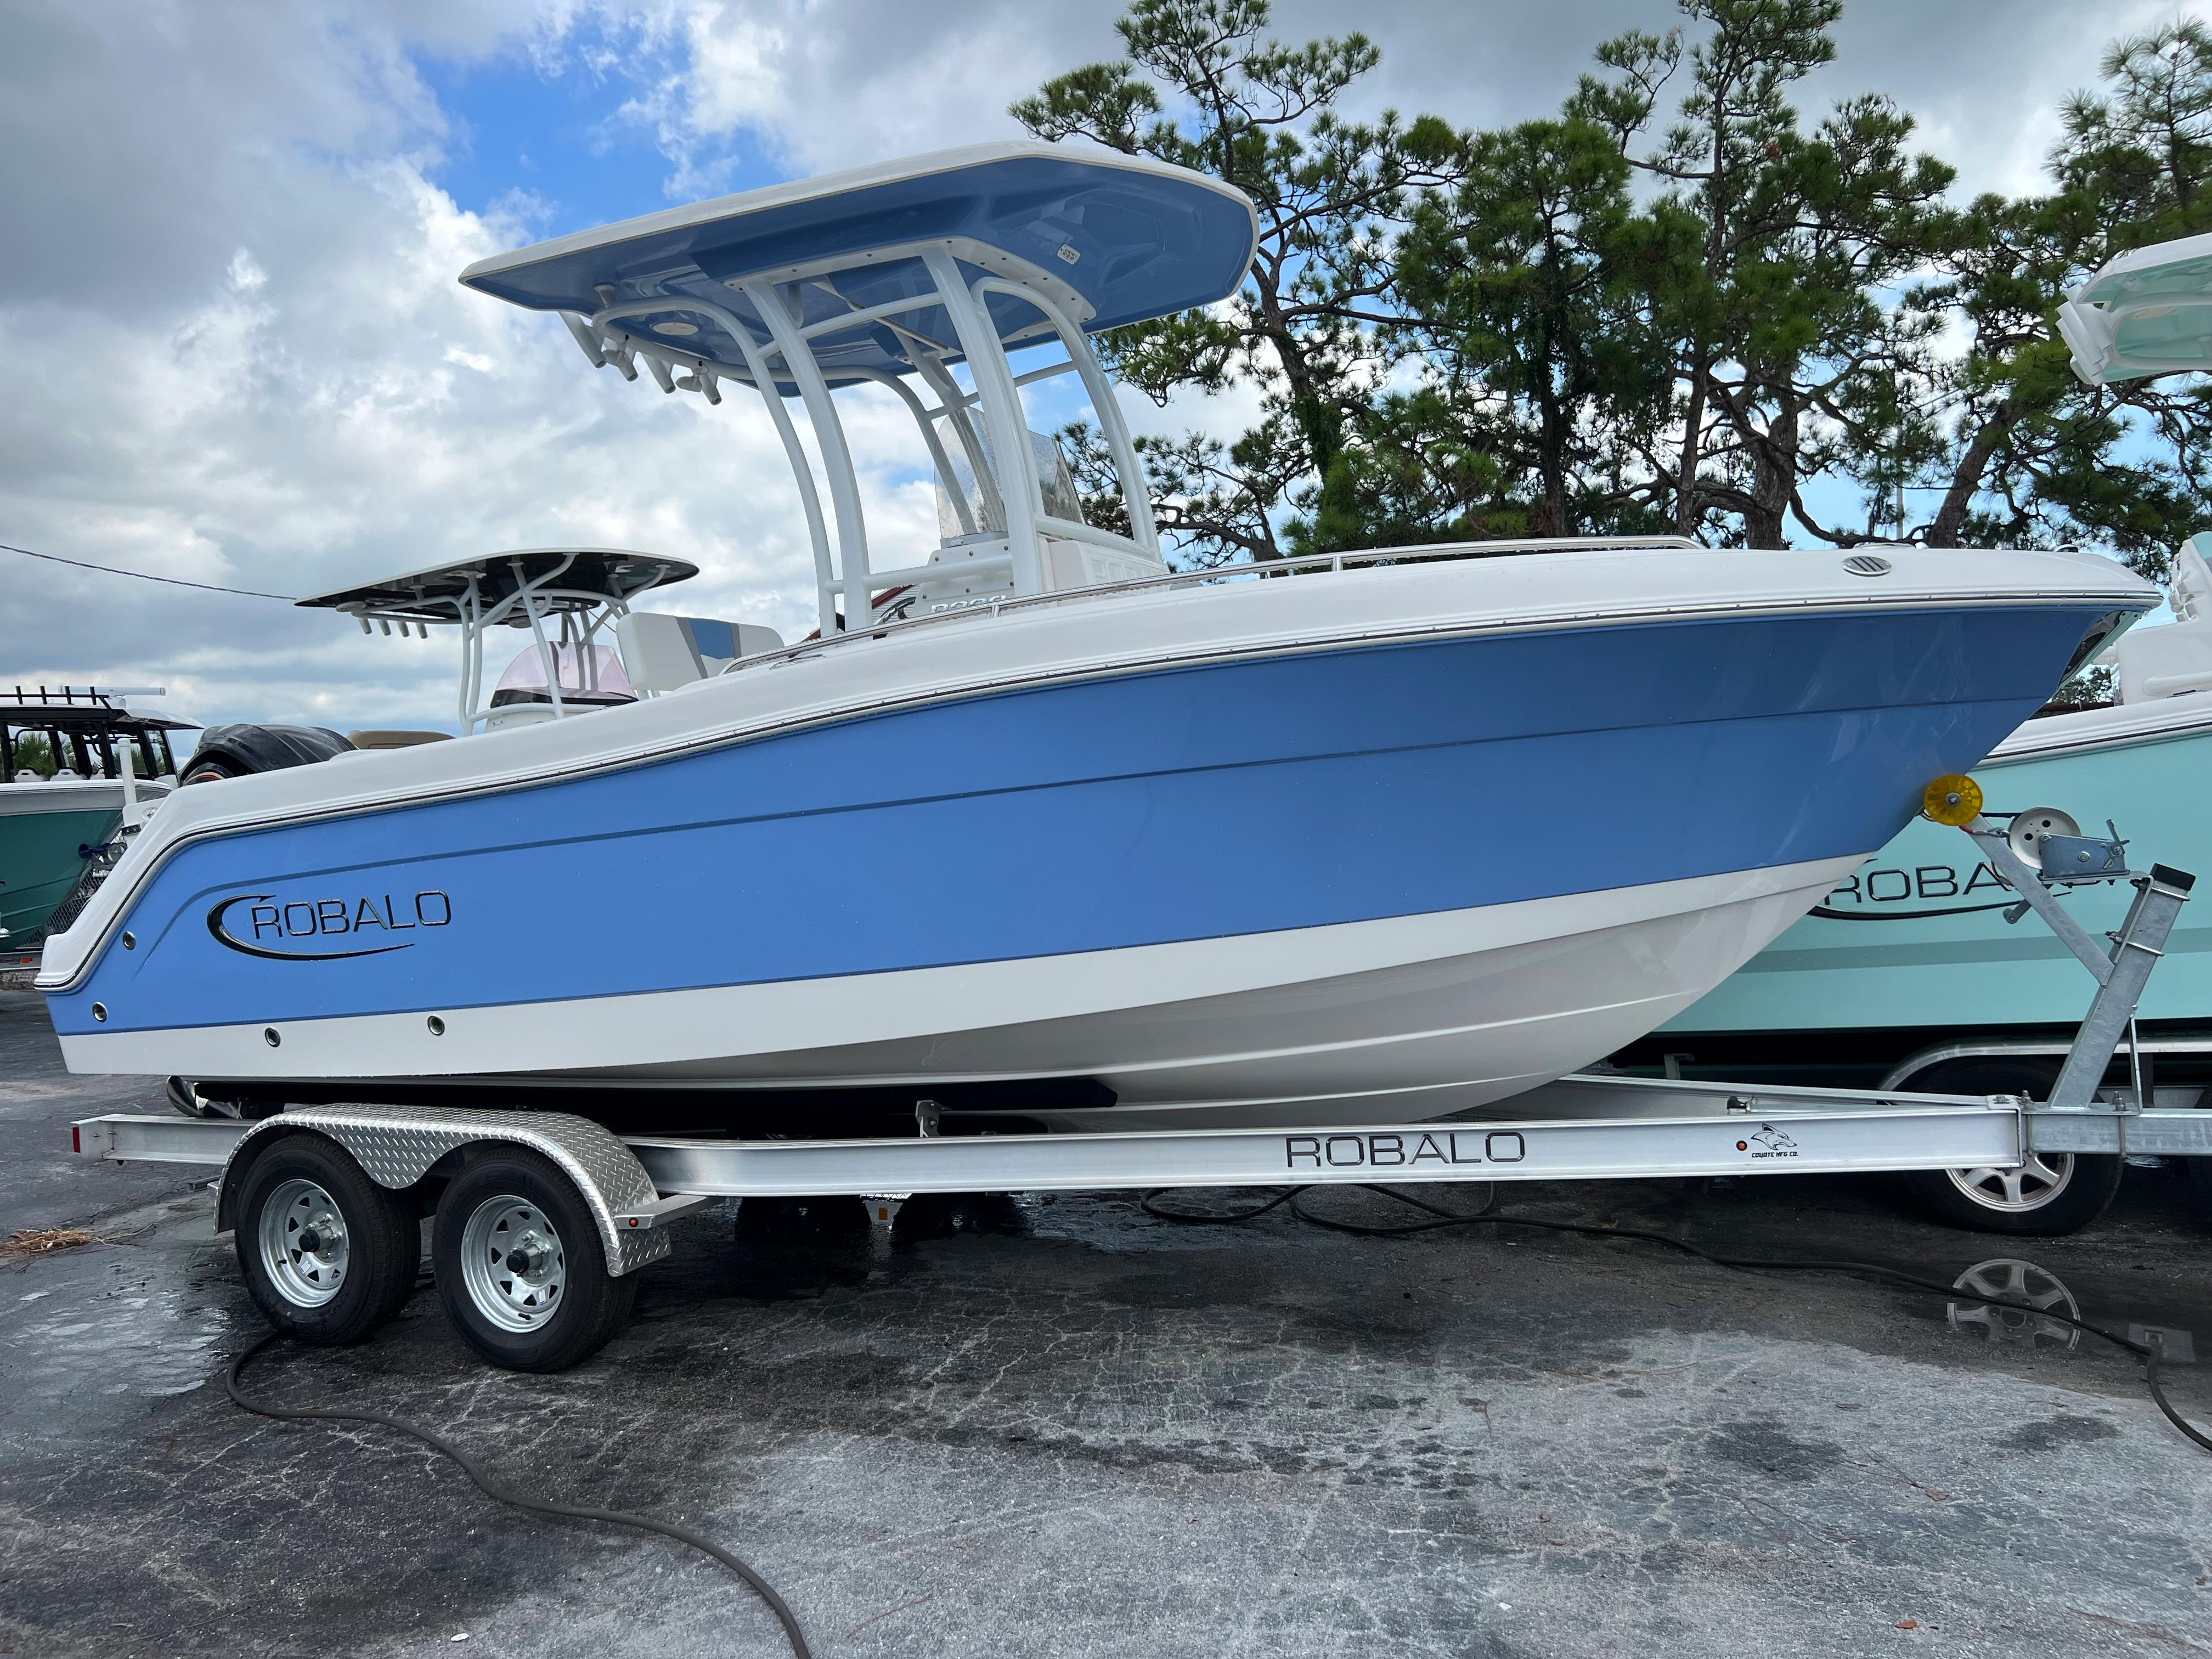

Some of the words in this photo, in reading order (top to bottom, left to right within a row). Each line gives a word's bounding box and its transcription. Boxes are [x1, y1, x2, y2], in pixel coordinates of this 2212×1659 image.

[1824, 861, 2012, 905] ROBA
[251, 889, 452, 939] ROBALO
[1286, 1132, 1525, 1167] ROBALO
